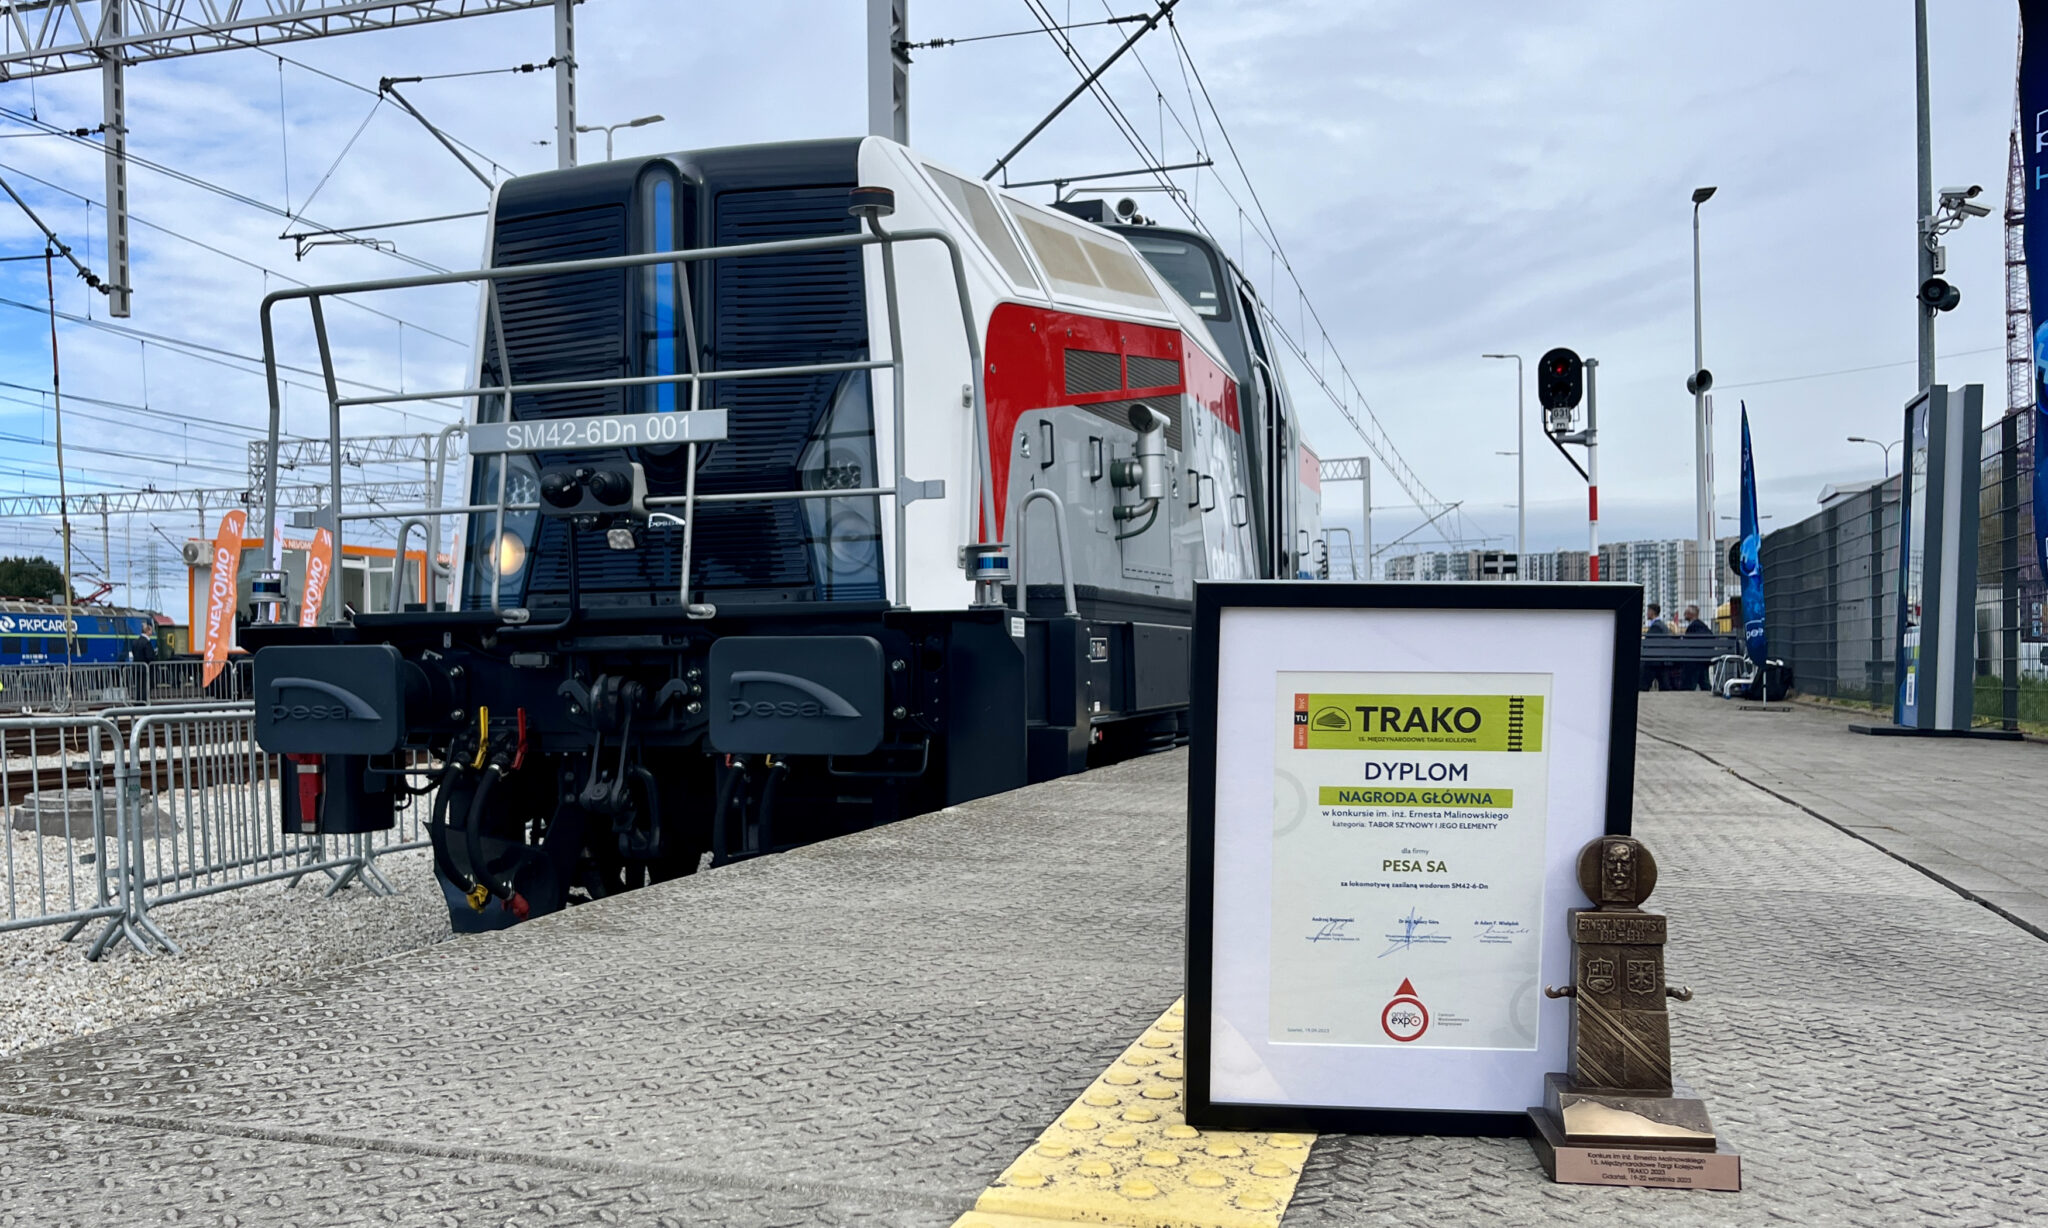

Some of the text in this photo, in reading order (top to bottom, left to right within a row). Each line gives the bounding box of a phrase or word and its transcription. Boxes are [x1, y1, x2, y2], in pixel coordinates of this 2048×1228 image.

[505, 414, 691, 450] SM42-6Dn 001
[209, 547, 230, 638] NEVOMO
[271, 704, 347, 726] pesa
[727, 699, 823, 722] pesa
[1295, 714, 1307, 723] TU
[1355, 706, 1482, 734] TRAKO
[1364, 761, 1468, 782] DYPLOM
[1338, 789, 1493, 805] NAGRODA GŁÓWNA
[1332, 808, 1374, 817] konkursie
[1376, 809, 1390, 817] im.
[1409, 810, 1442, 819] Ernesta
[1444, 810, 1509, 821] Malinowskiego
[1368, 821, 1394, 829] TABOR
[1395, 821, 1433, 829] SZYNOWY
[1459, 822, 1498, 830] ELEMENTY
[1412, 847, 1430, 856] firmy
[1382, 859, 1448, 873] PESA SA
[1349, 880, 1390, 889] lokomotywę
[1600, 1160, 1656, 1168] Międzynarodowe
[1627, 1167, 1649, 1175] TRAKO
